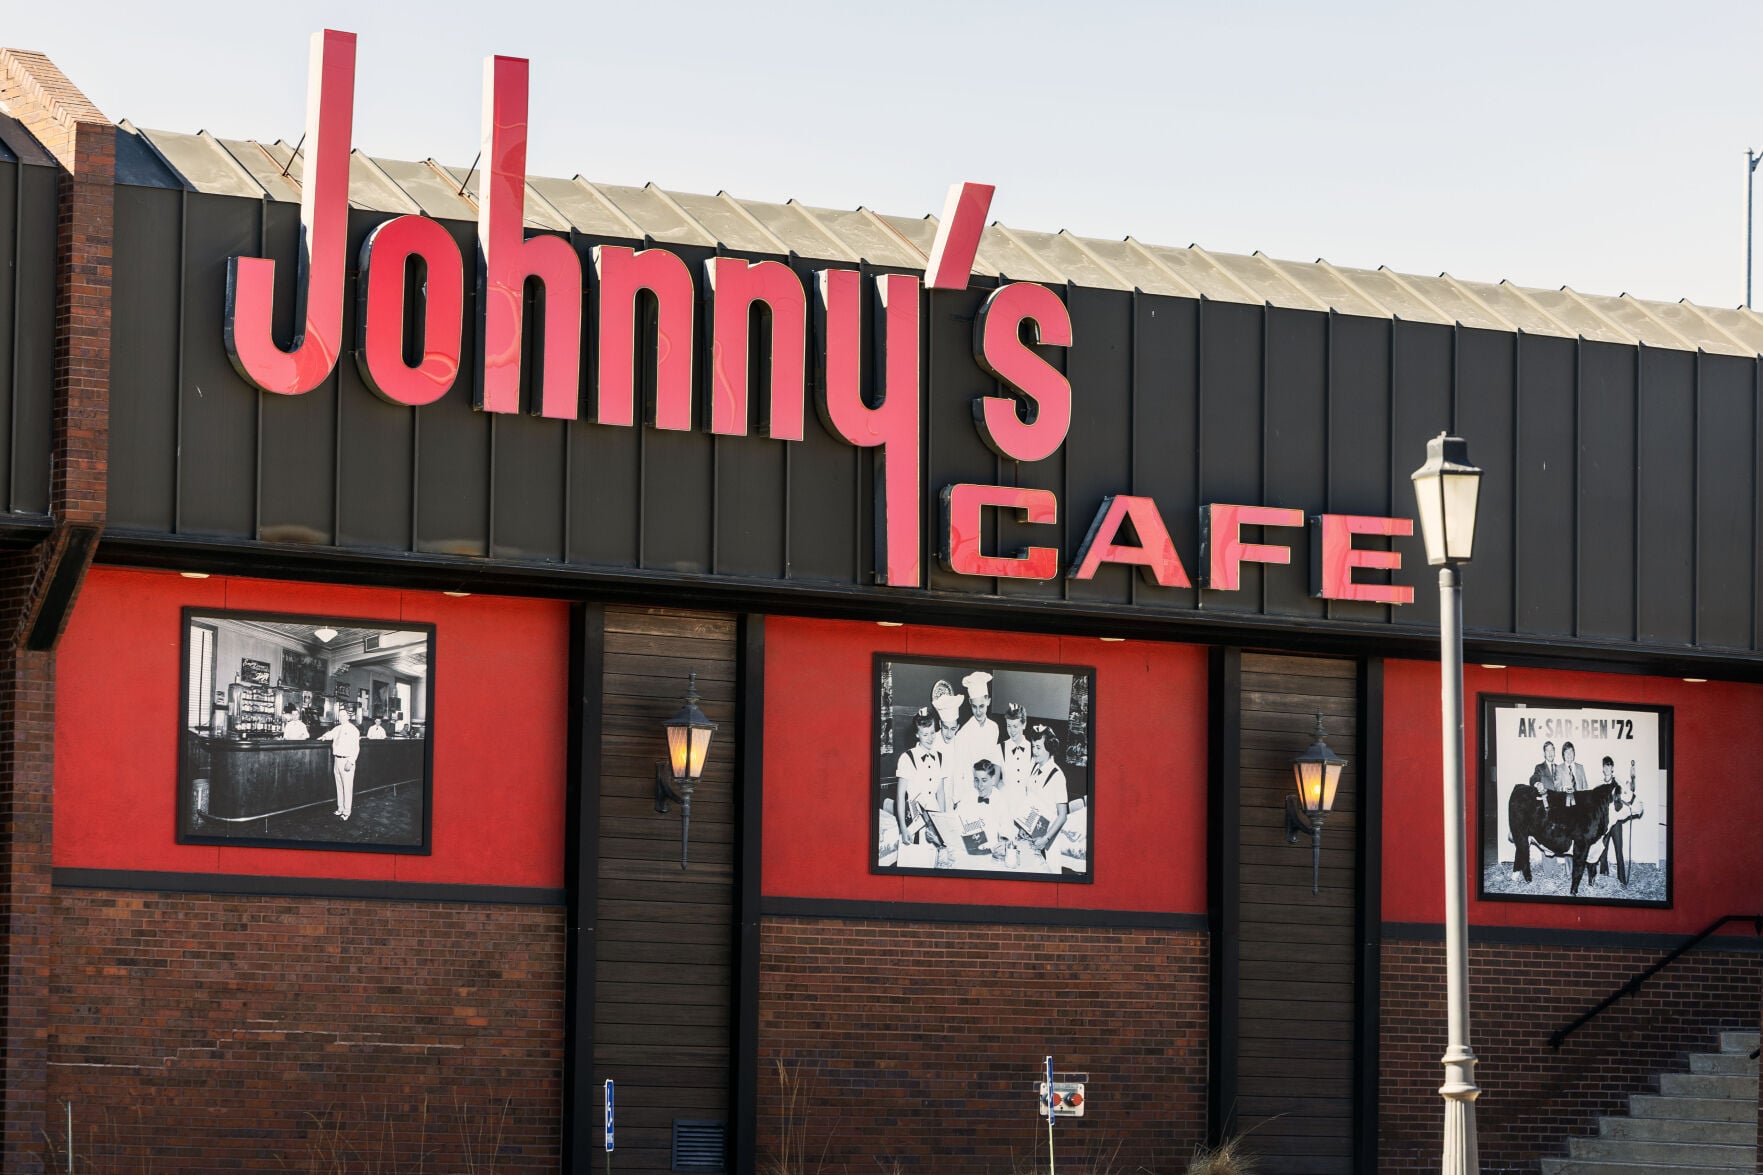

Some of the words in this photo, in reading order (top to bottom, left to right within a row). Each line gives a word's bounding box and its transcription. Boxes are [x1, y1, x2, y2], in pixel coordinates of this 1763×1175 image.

[225, 29, 1073, 588] Johnny's
[940, 483, 1414, 604] CAFE
[1611, 719, 1634, 740] '72
